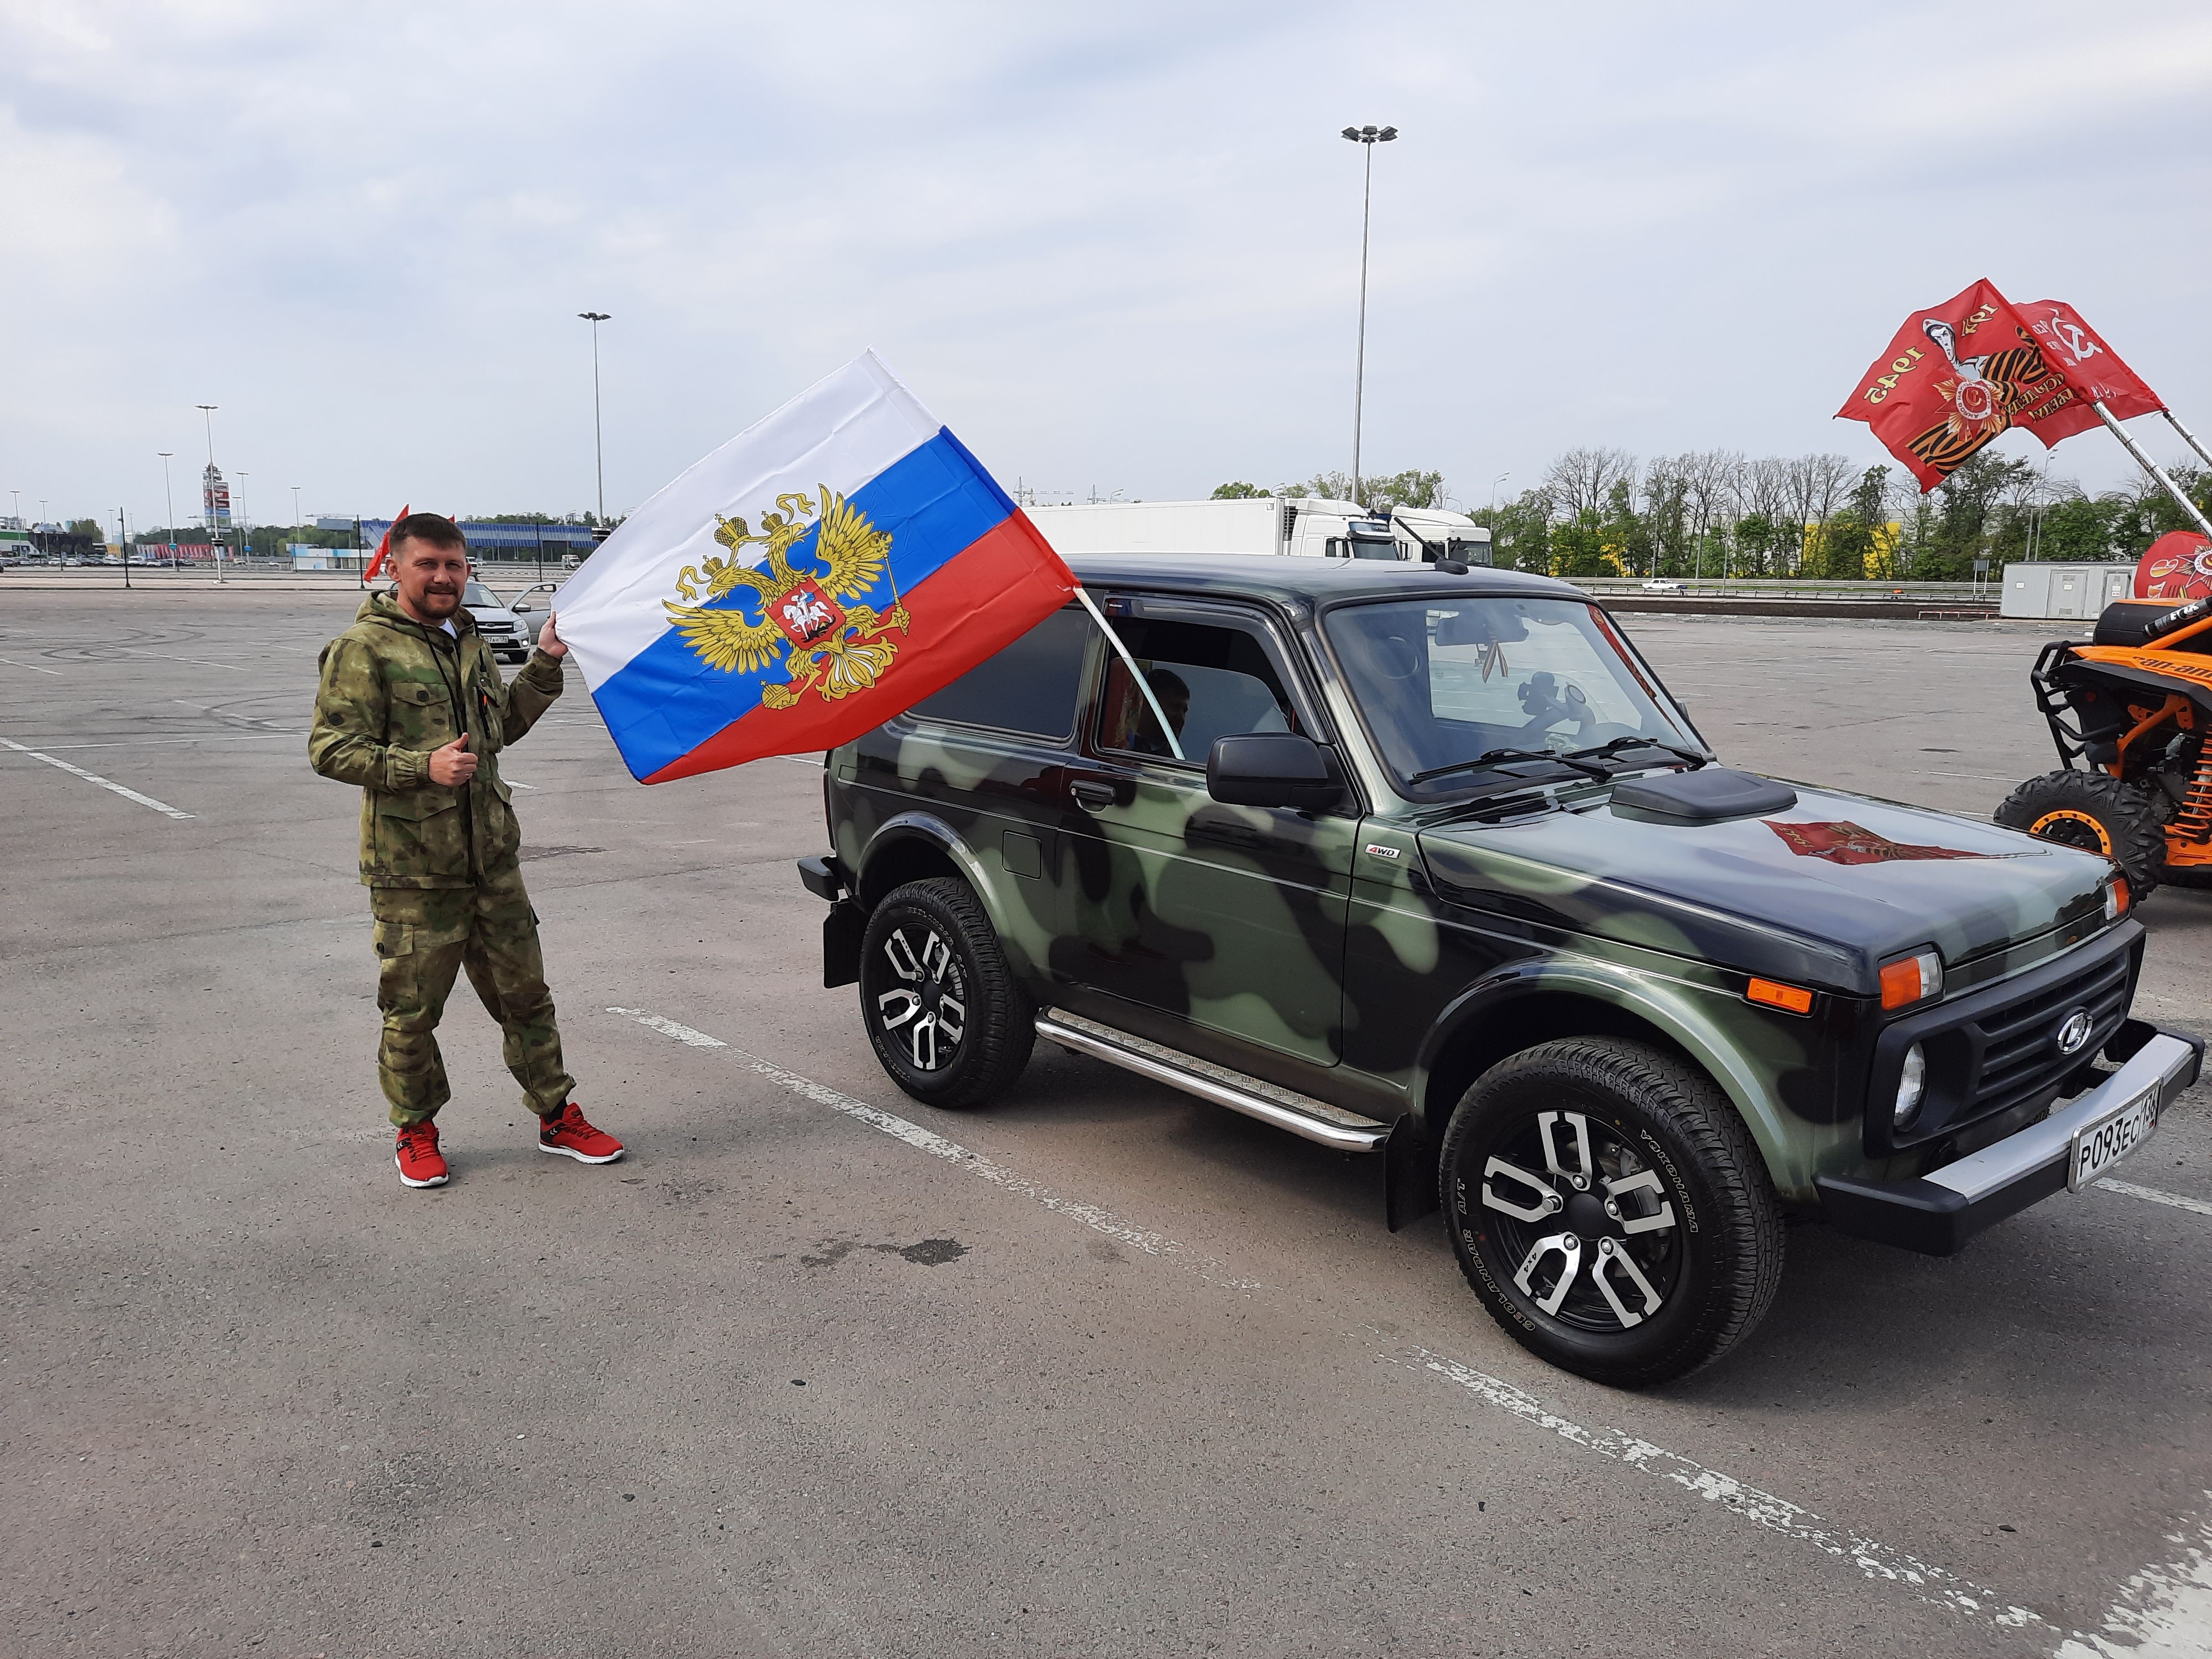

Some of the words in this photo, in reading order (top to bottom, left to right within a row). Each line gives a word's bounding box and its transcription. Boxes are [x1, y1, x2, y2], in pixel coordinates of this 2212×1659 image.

[2170, 602, 2199, 622] FOX
[1369, 847, 1395, 856] 4WD
[2079, 1114, 2140, 1178] Р093ЕС
[1457, 1177, 1468, 1215] A/T
[1640, 1128, 1699, 1233] YOKOHAMA
[1463, 1228, 1537, 1332] GEOLANDAR
